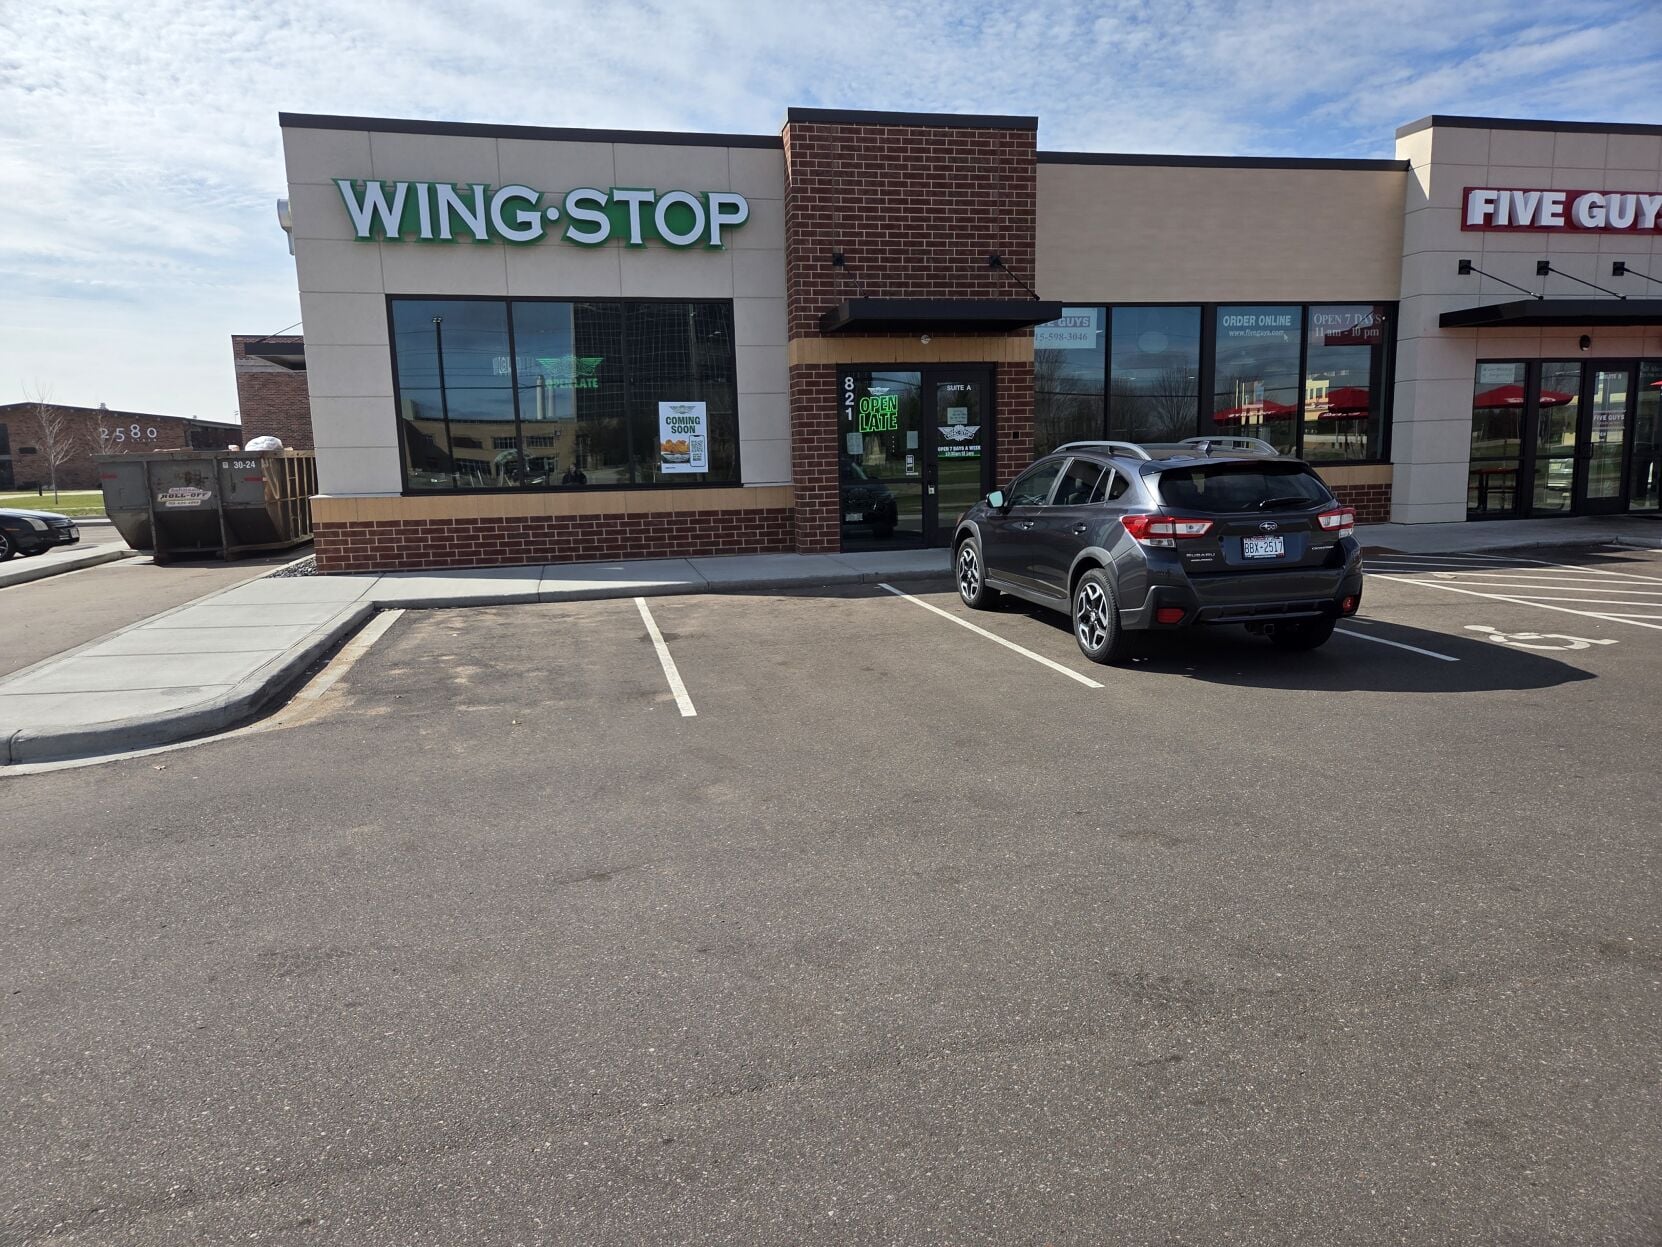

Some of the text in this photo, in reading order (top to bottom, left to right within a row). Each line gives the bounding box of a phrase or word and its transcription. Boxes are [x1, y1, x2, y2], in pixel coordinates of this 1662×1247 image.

[1466, 189, 1662, 229] FIVE GUY
[1058, 317, 1089, 327] GUYS
[1223, 315, 1292, 326] ORDER ONLINE
[1313, 313, 1381, 325] OPEN 7 DAYS
[1036, 332, 1088, 341] 15-598-3046
[1315, 327, 1324, 336] 11
[1326, 329, 1341, 337] am
[1351, 327, 1361, 336] 10
[1364, 329, 1379, 339] pm
[576, 378, 599, 388] LATE
[860, 395, 898, 414] OPEN
[665, 416, 701, 425] COMING
[859, 412, 898, 432] LATE
[99, 423, 157, 442] 2580
[671, 425, 696, 434] SOON
[233, 460, 256, 469] 30-24
[1244, 541, 1283, 554] BBX-2517
